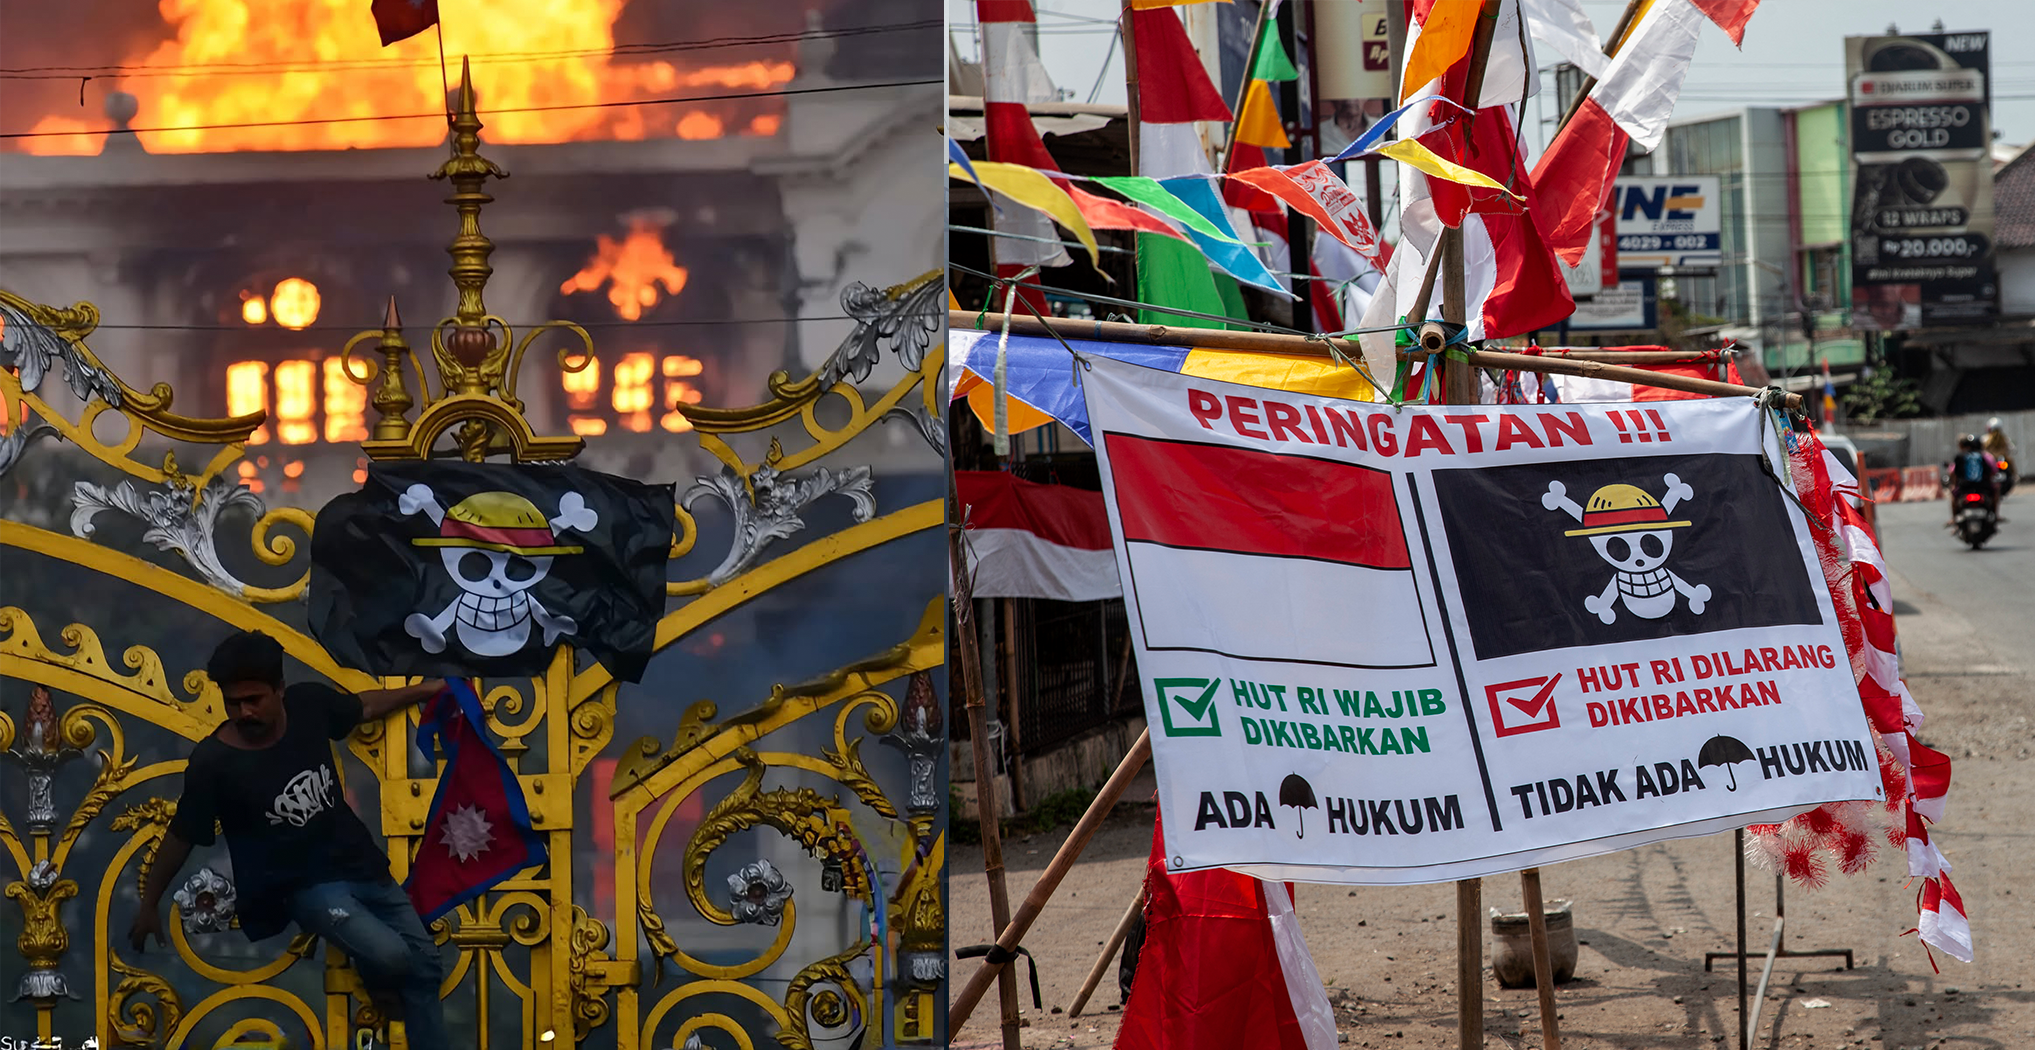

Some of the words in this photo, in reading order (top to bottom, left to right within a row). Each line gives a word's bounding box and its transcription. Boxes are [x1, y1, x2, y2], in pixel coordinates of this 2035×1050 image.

[1943, 34, 1987, 53] NEW
[1934, 80, 1975, 92] SUPER
[1866, 105, 1970, 131] ESPRESSO
[1887, 129, 1949, 149] GOLD
[1615, 185, 1704, 221] NE
[1901, 208, 1961, 226] WRAPS
[1619, 235, 1661, 251] 4029
[1674, 234, 1707, 250] 002
[1653, 221, 1695, 232] EXPRESS
[1187, 388, 1594, 458] PERINGATAN
[1605, 409, 1672, 444] !!!
[1576, 662, 1641, 694] HUT
[1650, 657, 1686, 685] RI
[1689, 644, 1836, 680] DILARANG
[1229, 677, 1288, 712] HUT
[1296, 686, 1330, 716] RI
[1332, 688, 1447, 719] WAJIB
[1585, 681, 1782, 729] DIKIBARKAN
[1240, 715, 1432, 756] DIKIBARKAN
[1510, 768, 1627, 820] TIDAK
[1636, 758, 1706, 800] ADA
[1756, 740, 1869, 780] HUKUM
[1194, 791, 1276, 831] ADA
[1325, 795, 1465, 836] HUKUM
